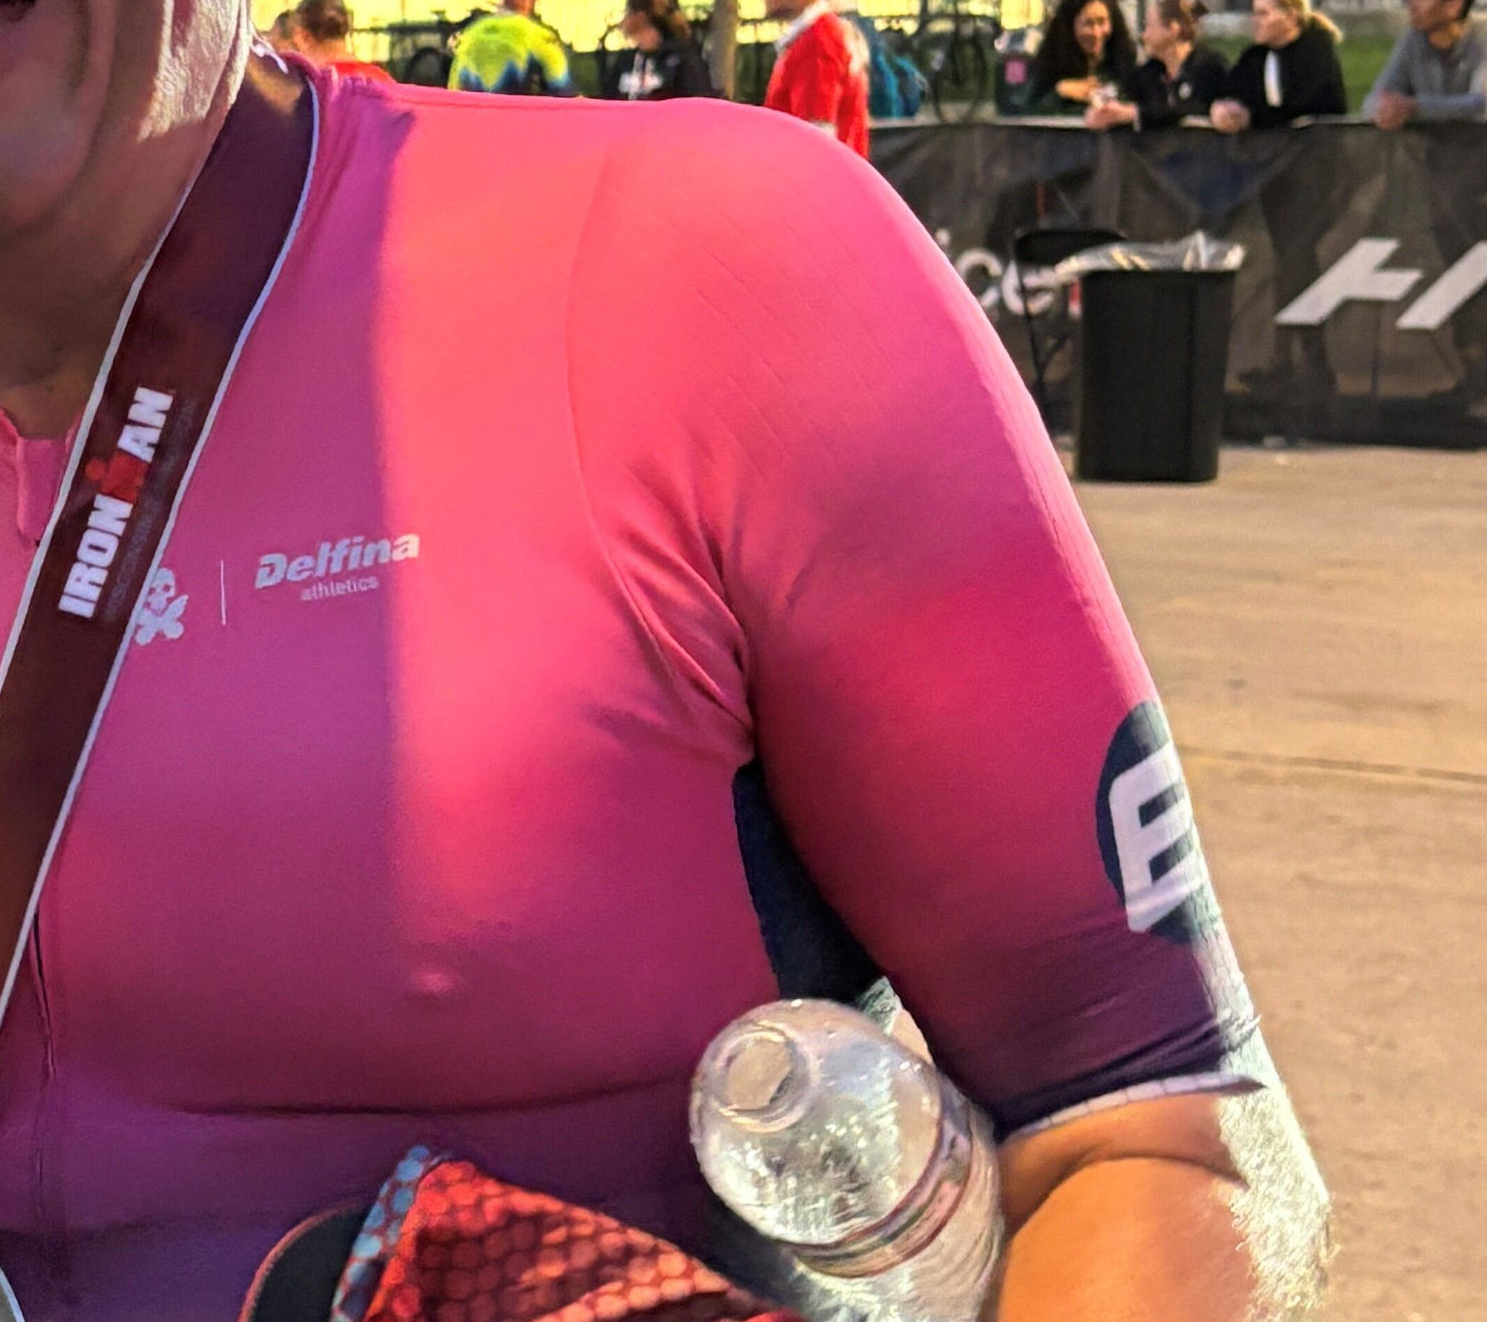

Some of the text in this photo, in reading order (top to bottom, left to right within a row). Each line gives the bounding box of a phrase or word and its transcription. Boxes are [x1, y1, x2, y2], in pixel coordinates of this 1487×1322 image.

[58, 387, 174, 620] IRONMAN
[255, 534, 420, 589] Delfina
[300, 576, 380, 602] athletics
